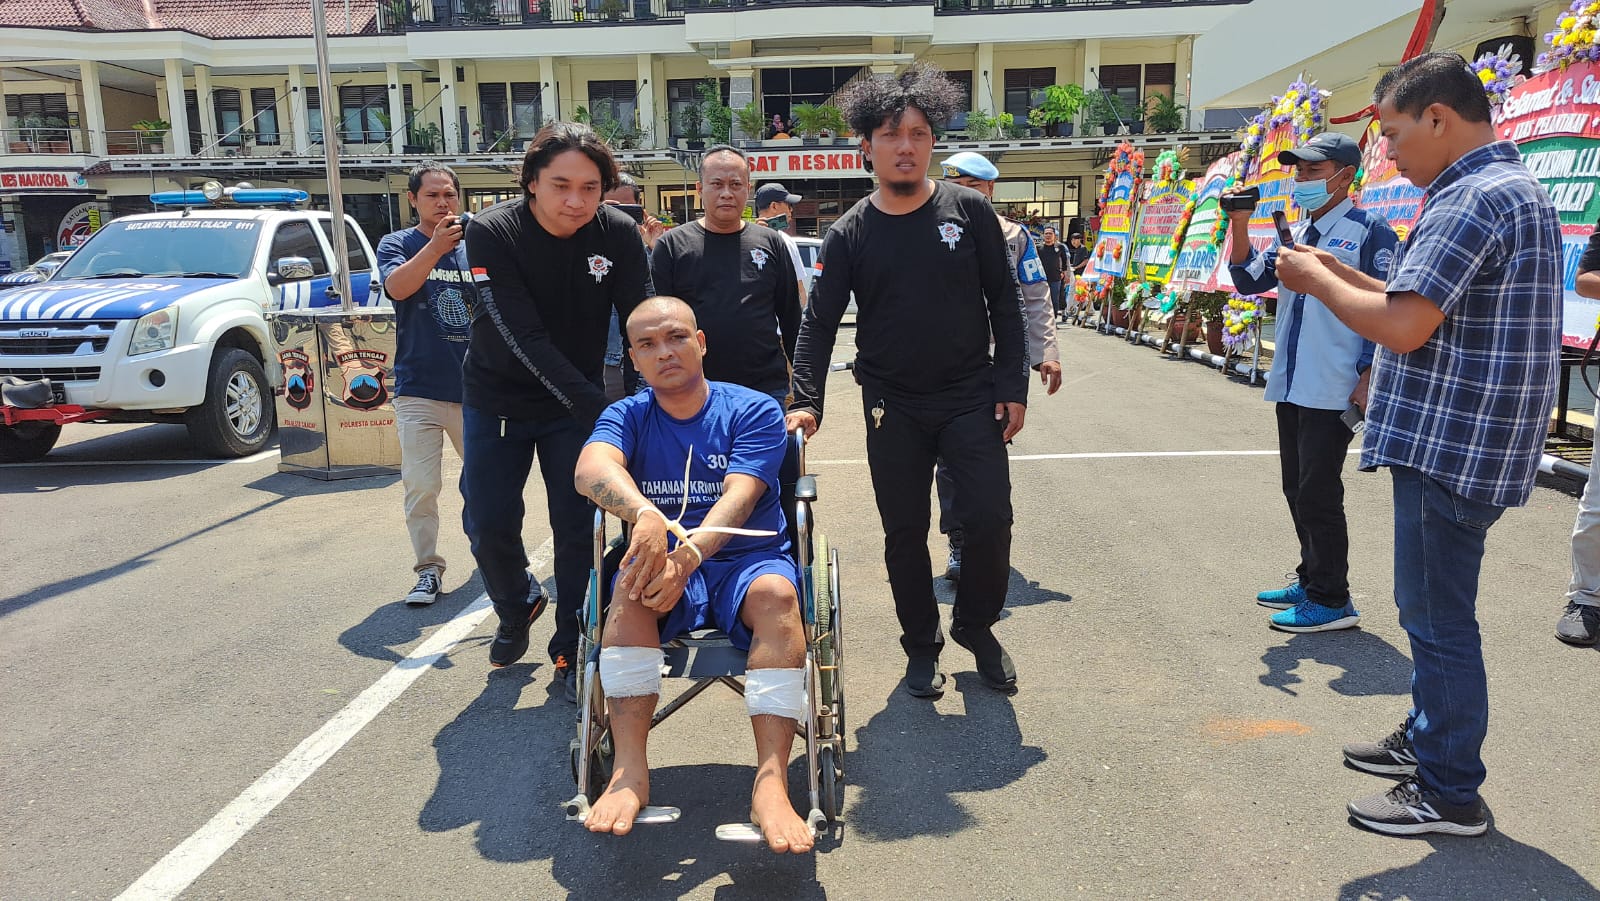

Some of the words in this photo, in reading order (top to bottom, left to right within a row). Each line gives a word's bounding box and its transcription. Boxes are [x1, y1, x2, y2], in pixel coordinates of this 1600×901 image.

[1497, 80, 1559, 124] Selamat
[747, 155, 780, 172] SAT
[788, 153, 862, 171] RESKRI
[19, 173, 69, 187] NARKOBA
[124, 222, 164, 230] SATLANTAS
[162, 221, 199, 229] POLRESTA
[200, 221, 233, 229] CILACAP
[427, 268, 473, 283] IMENSIO
[341, 352, 358, 362] JAWA
[359, 351, 384, 361] TENGAH
[340, 420, 369, 429] POLRESTA
[370, 419, 394, 427] CILACAP
[707, 454, 727, 469] 30
[642, 480, 686, 495] TAHANAN
[677, 496, 702, 504] RSTA
